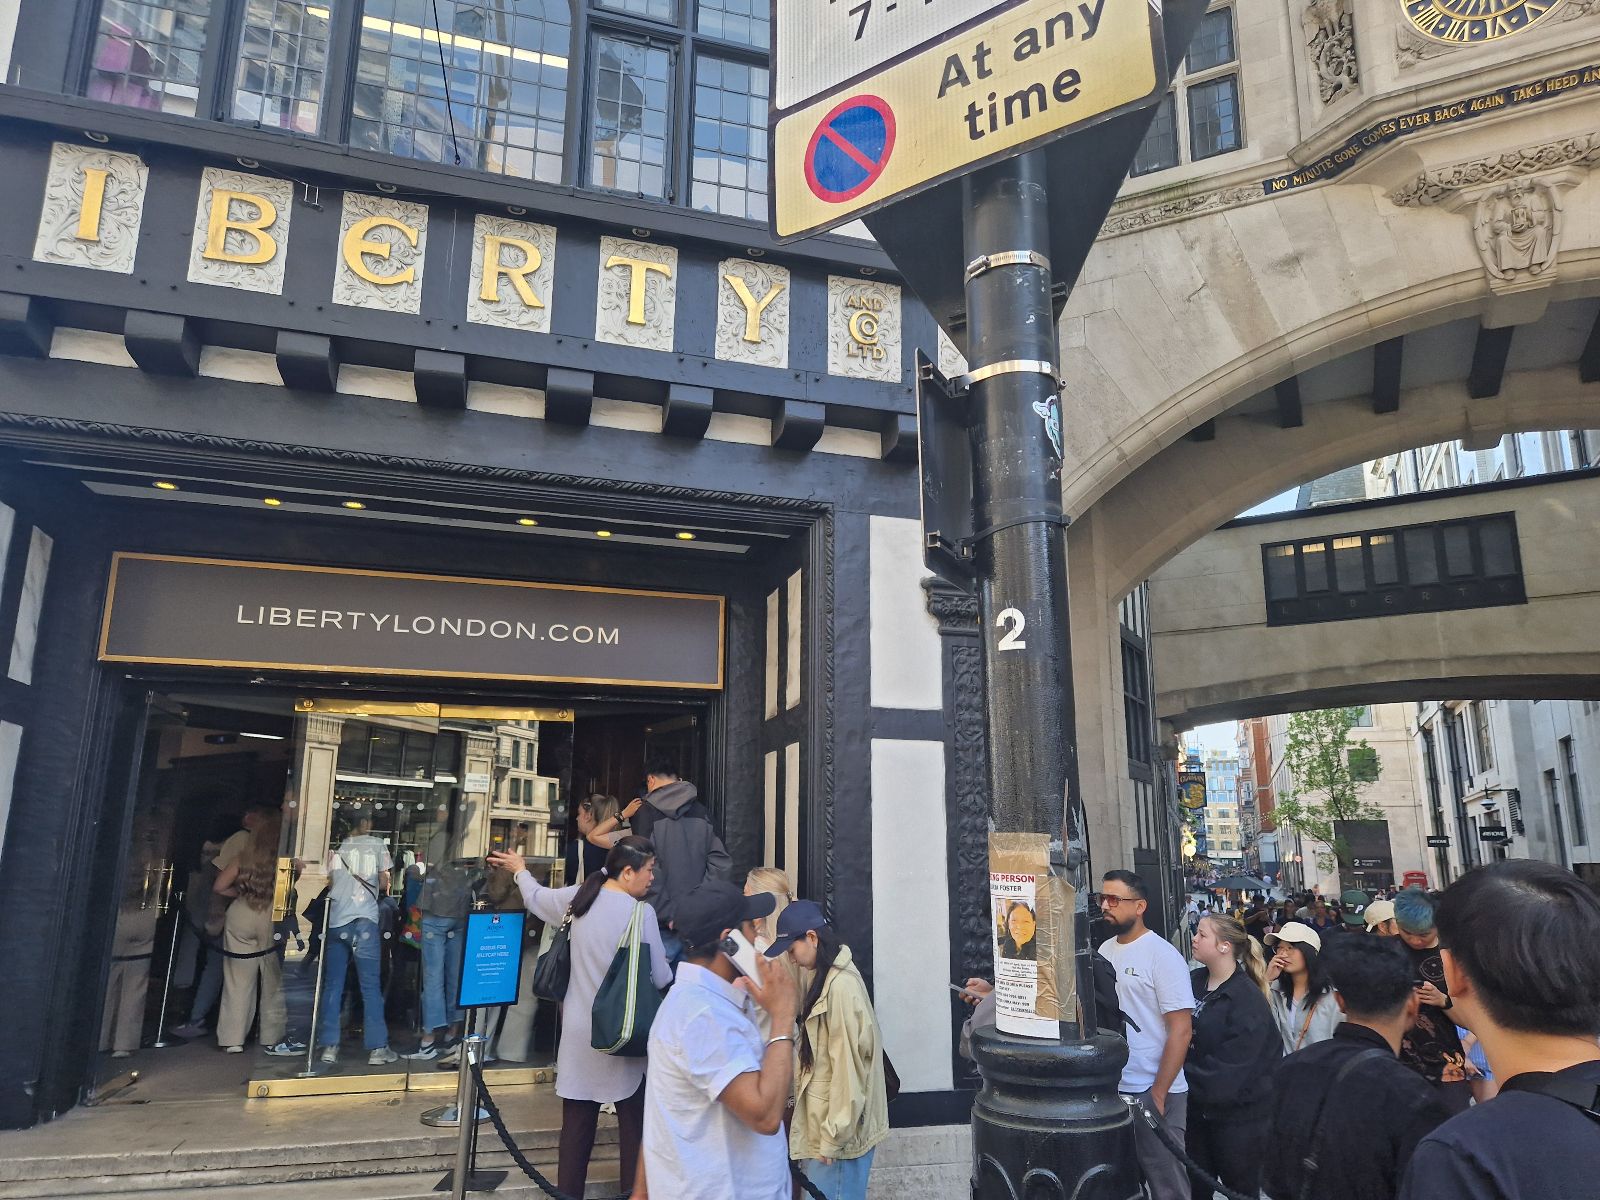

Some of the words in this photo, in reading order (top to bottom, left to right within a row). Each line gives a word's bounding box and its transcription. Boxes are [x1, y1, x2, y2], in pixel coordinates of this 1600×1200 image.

[937, 41, 992, 99] At
[1013, 0, 1105, 62] any
[963, 68, 1081, 141] time
[1271, 179, 1288, 191] NO
[1292, 158, 1334, 186] MINUTE
[1334, 143, 1361, 164] GONE
[1362, 121, 1396, 146] COMES
[1399, 112, 1430, 129] EVER
[1435, 104, 1466, 121] BACK
[1470, 93, 1505, 111] AGAIN
[1511, 83, 1543, 102] TAKE
[1546, 74, 1578, 92] HEED
[847, 295, 884, 312] AND
[847, 343, 885, 361] LTD
[236, 604, 620, 645] LIBERTYLONDON.COM
[995, 607, 1027, 651] 2
[1353, 859, 1360, 867] 2
[1001, 874, 1035, 883] PERSON
[1000, 884, 1022, 892] FOSTER
[1354, 904, 1364, 914] P
